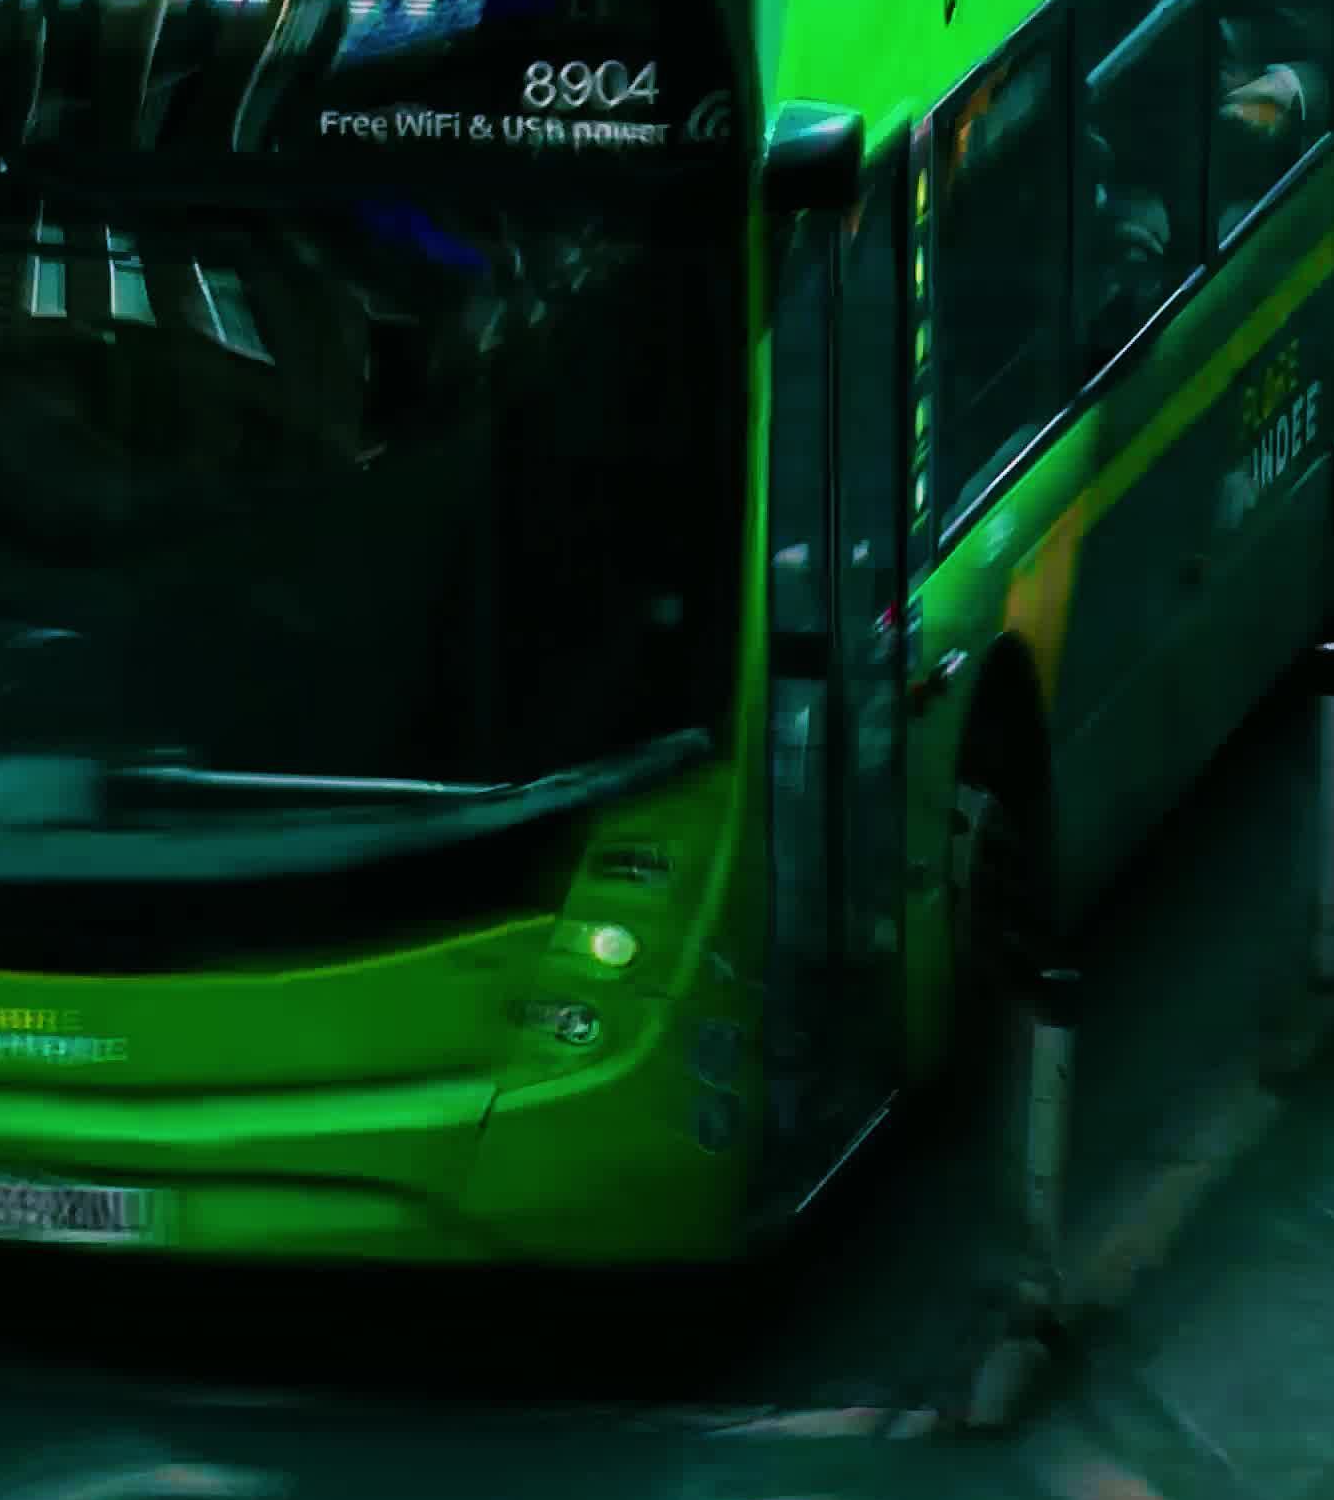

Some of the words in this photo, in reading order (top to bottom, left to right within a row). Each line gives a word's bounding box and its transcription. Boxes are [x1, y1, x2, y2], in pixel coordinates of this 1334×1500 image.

[522, 58, 660, 110] 8904
[320, 110, 388, 140] Free
[467, 113, 493, 142] &
